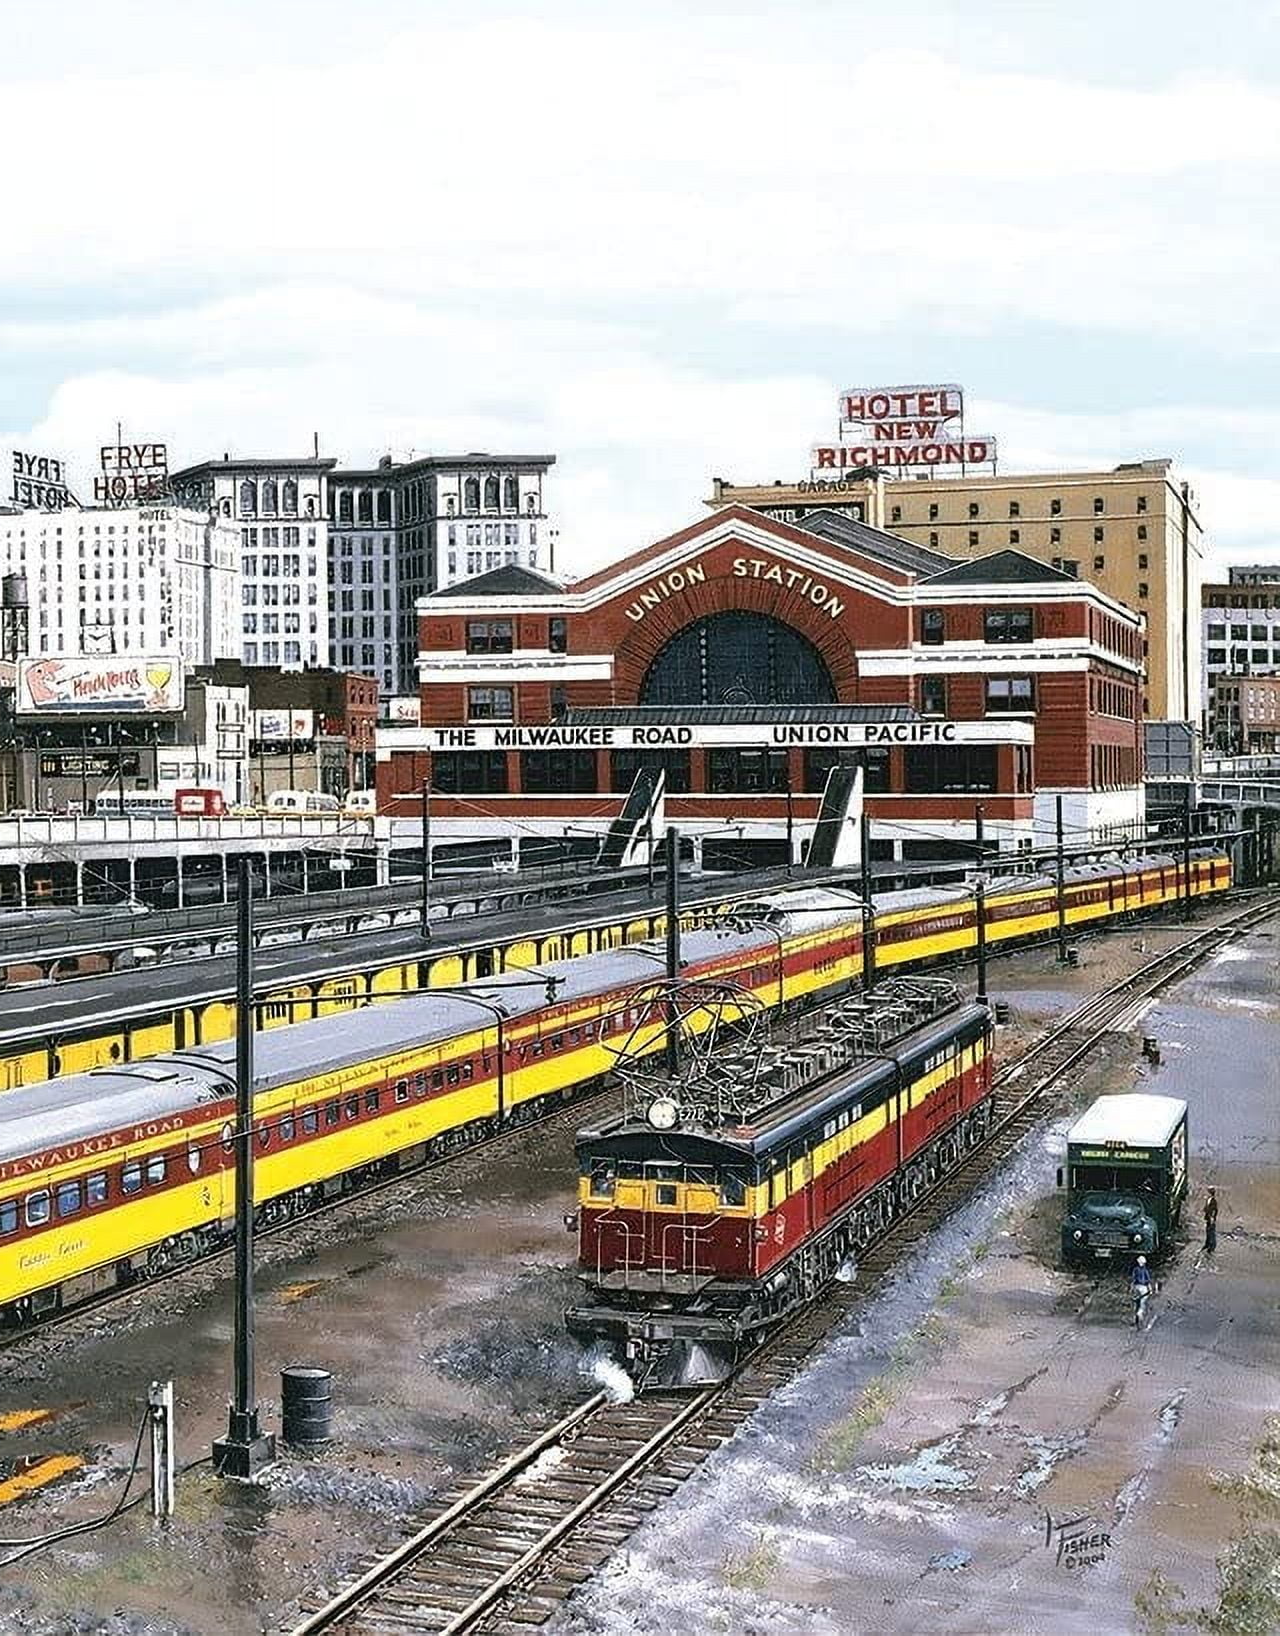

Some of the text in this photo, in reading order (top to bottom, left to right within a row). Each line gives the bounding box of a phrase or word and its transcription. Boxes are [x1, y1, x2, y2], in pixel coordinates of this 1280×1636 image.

[847, 391, 960, 419] HOTEL
[874, 421, 938, 440] NEW
[101, 444, 166, 469] FRYE
[817, 442, 987, 468] RICHMOND
[625, 558, 845, 622] UNION STATION
[435, 727, 692, 746] THE MILWAUKEE ROAD
[772, 724, 956, 743] UNION PACIFIC
[134, 1117, 184, 1141] ROAD
